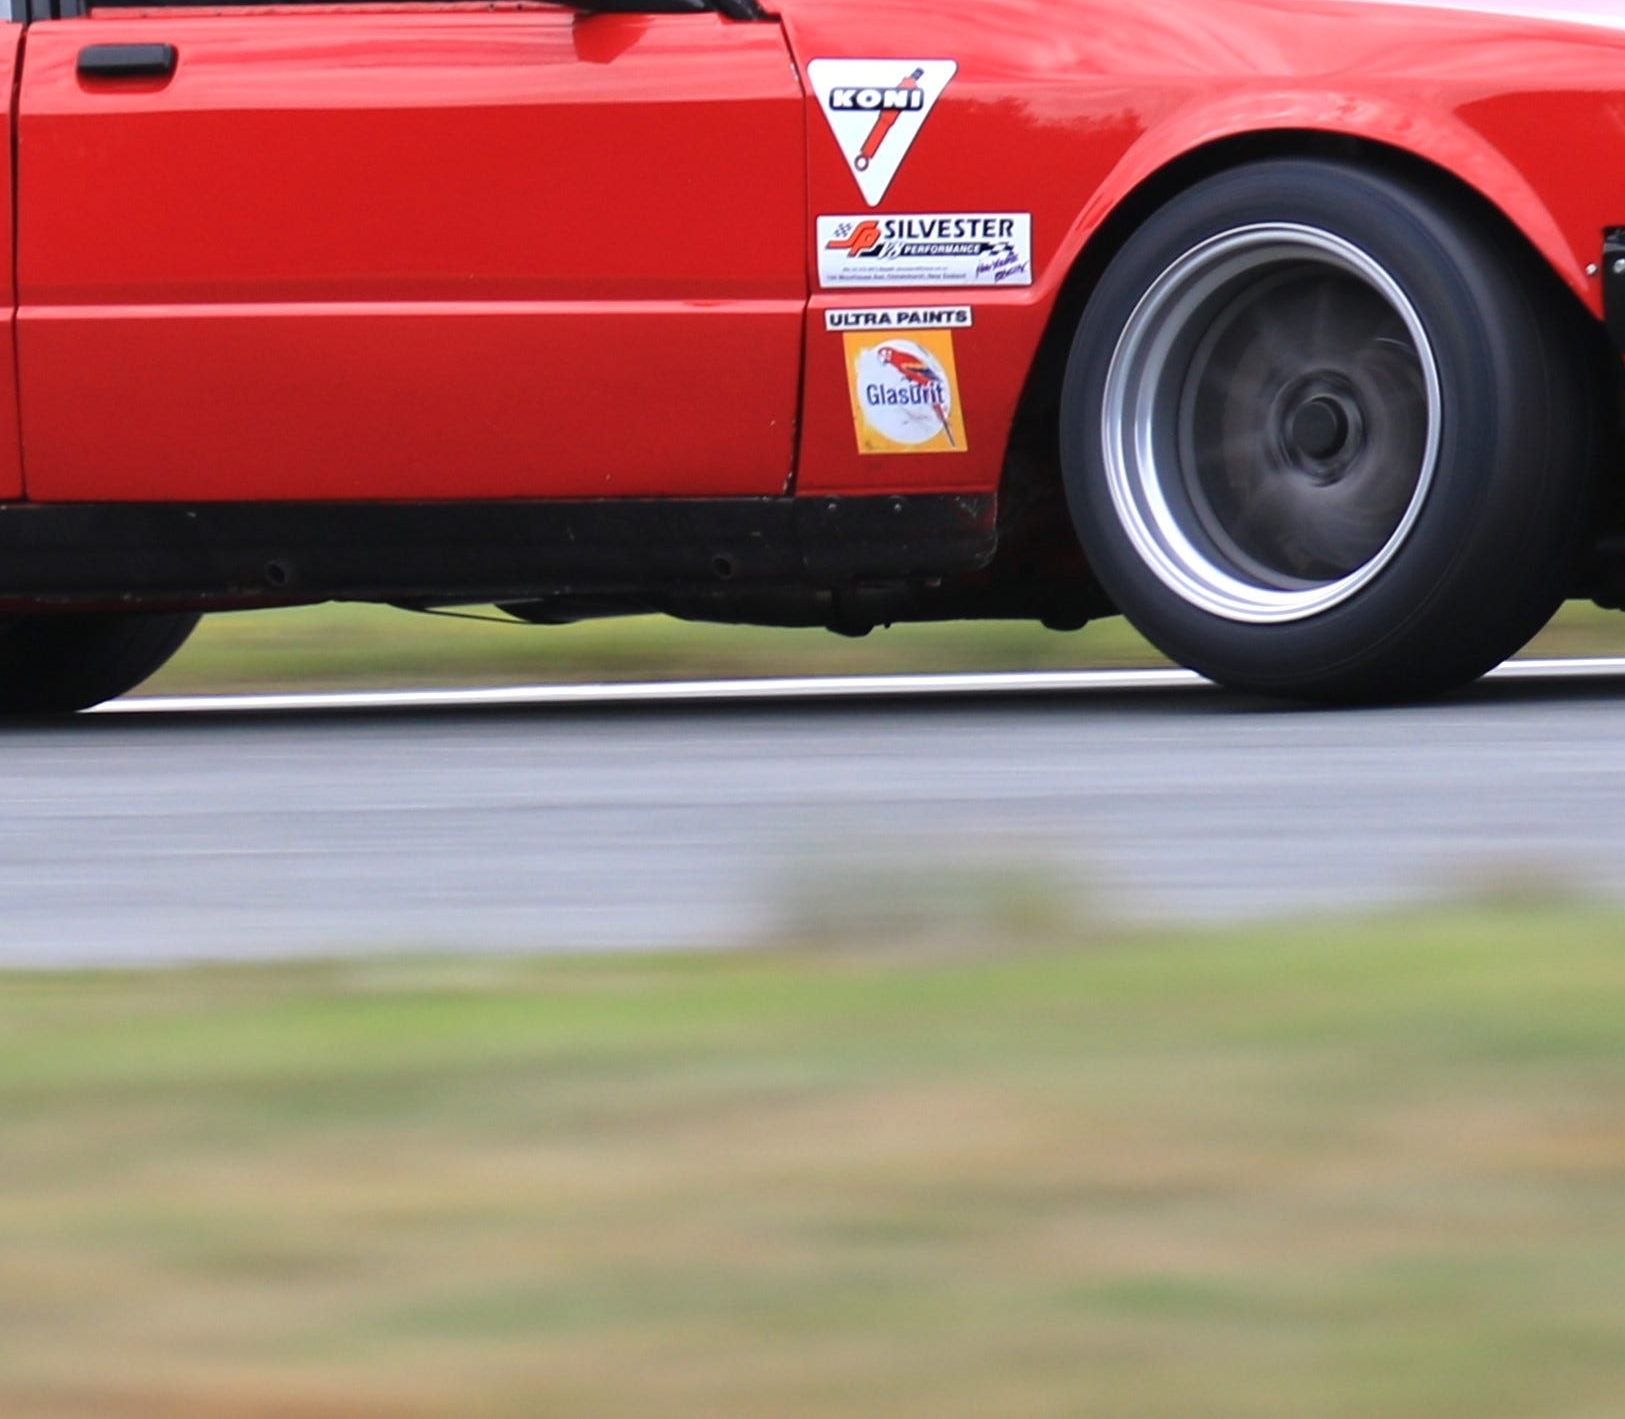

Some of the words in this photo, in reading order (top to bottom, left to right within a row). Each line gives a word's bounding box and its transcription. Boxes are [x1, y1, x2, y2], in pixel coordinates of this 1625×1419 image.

[832, 89, 922, 109] KONI
[883, 217, 1015, 239] SILVESTER
[903, 242, 980, 255] PERFORMANCE
[829, 311, 891, 327] ULTRA
[896, 309, 968, 325] PAINTS
[865, 382, 945, 407] Glasurit
